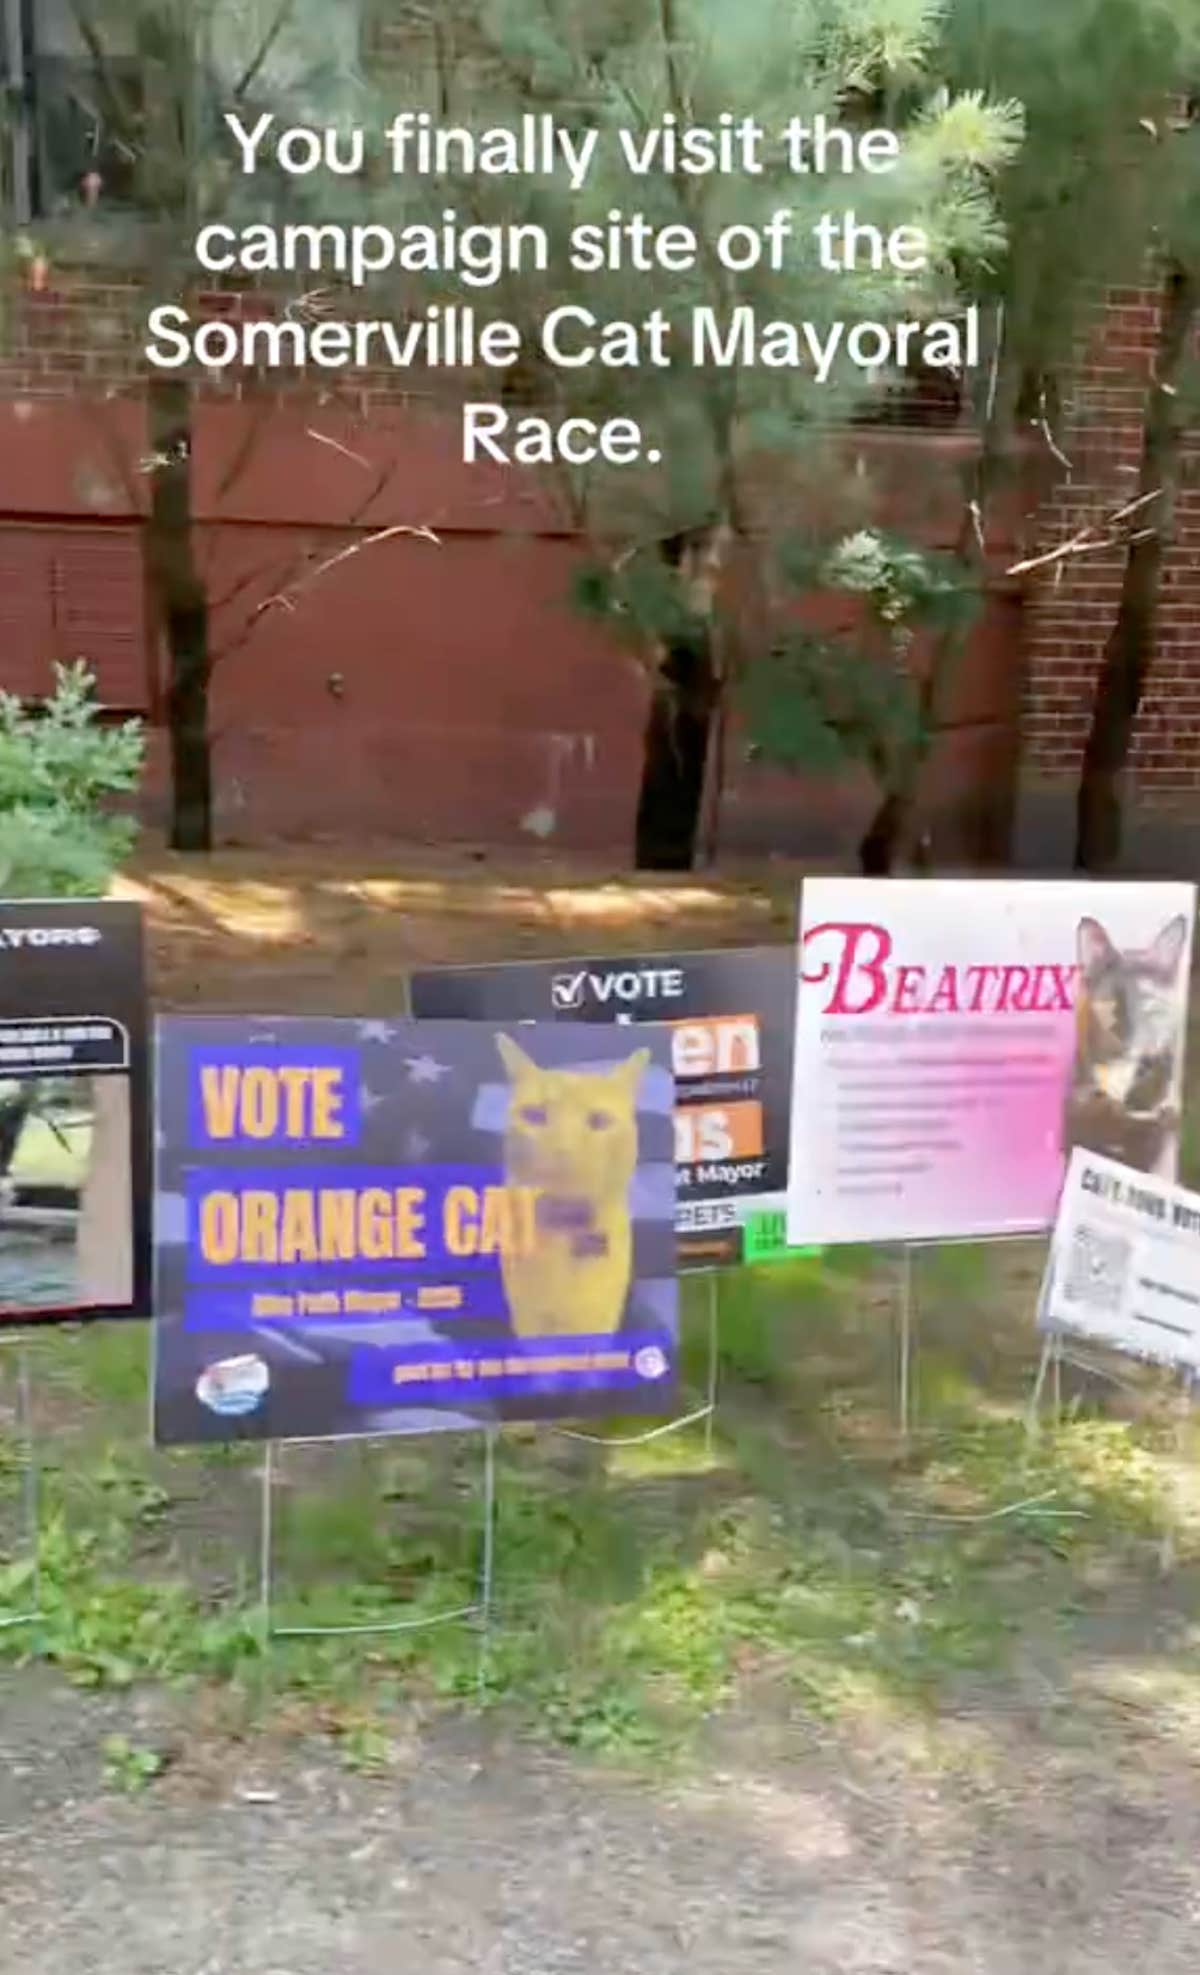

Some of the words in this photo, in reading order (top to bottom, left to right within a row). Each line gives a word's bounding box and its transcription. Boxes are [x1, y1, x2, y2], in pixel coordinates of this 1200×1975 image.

[589, 968, 685, 1001] VOTE
[801, 921, 1083, 1015] BEATRIX
[200, 1064, 346, 1140] VOTE
[698, 1162, 766, 1186] Mayor
[201, 1186, 427, 1265] ORANGE
[443, 1185, 545, 1257] CAT
